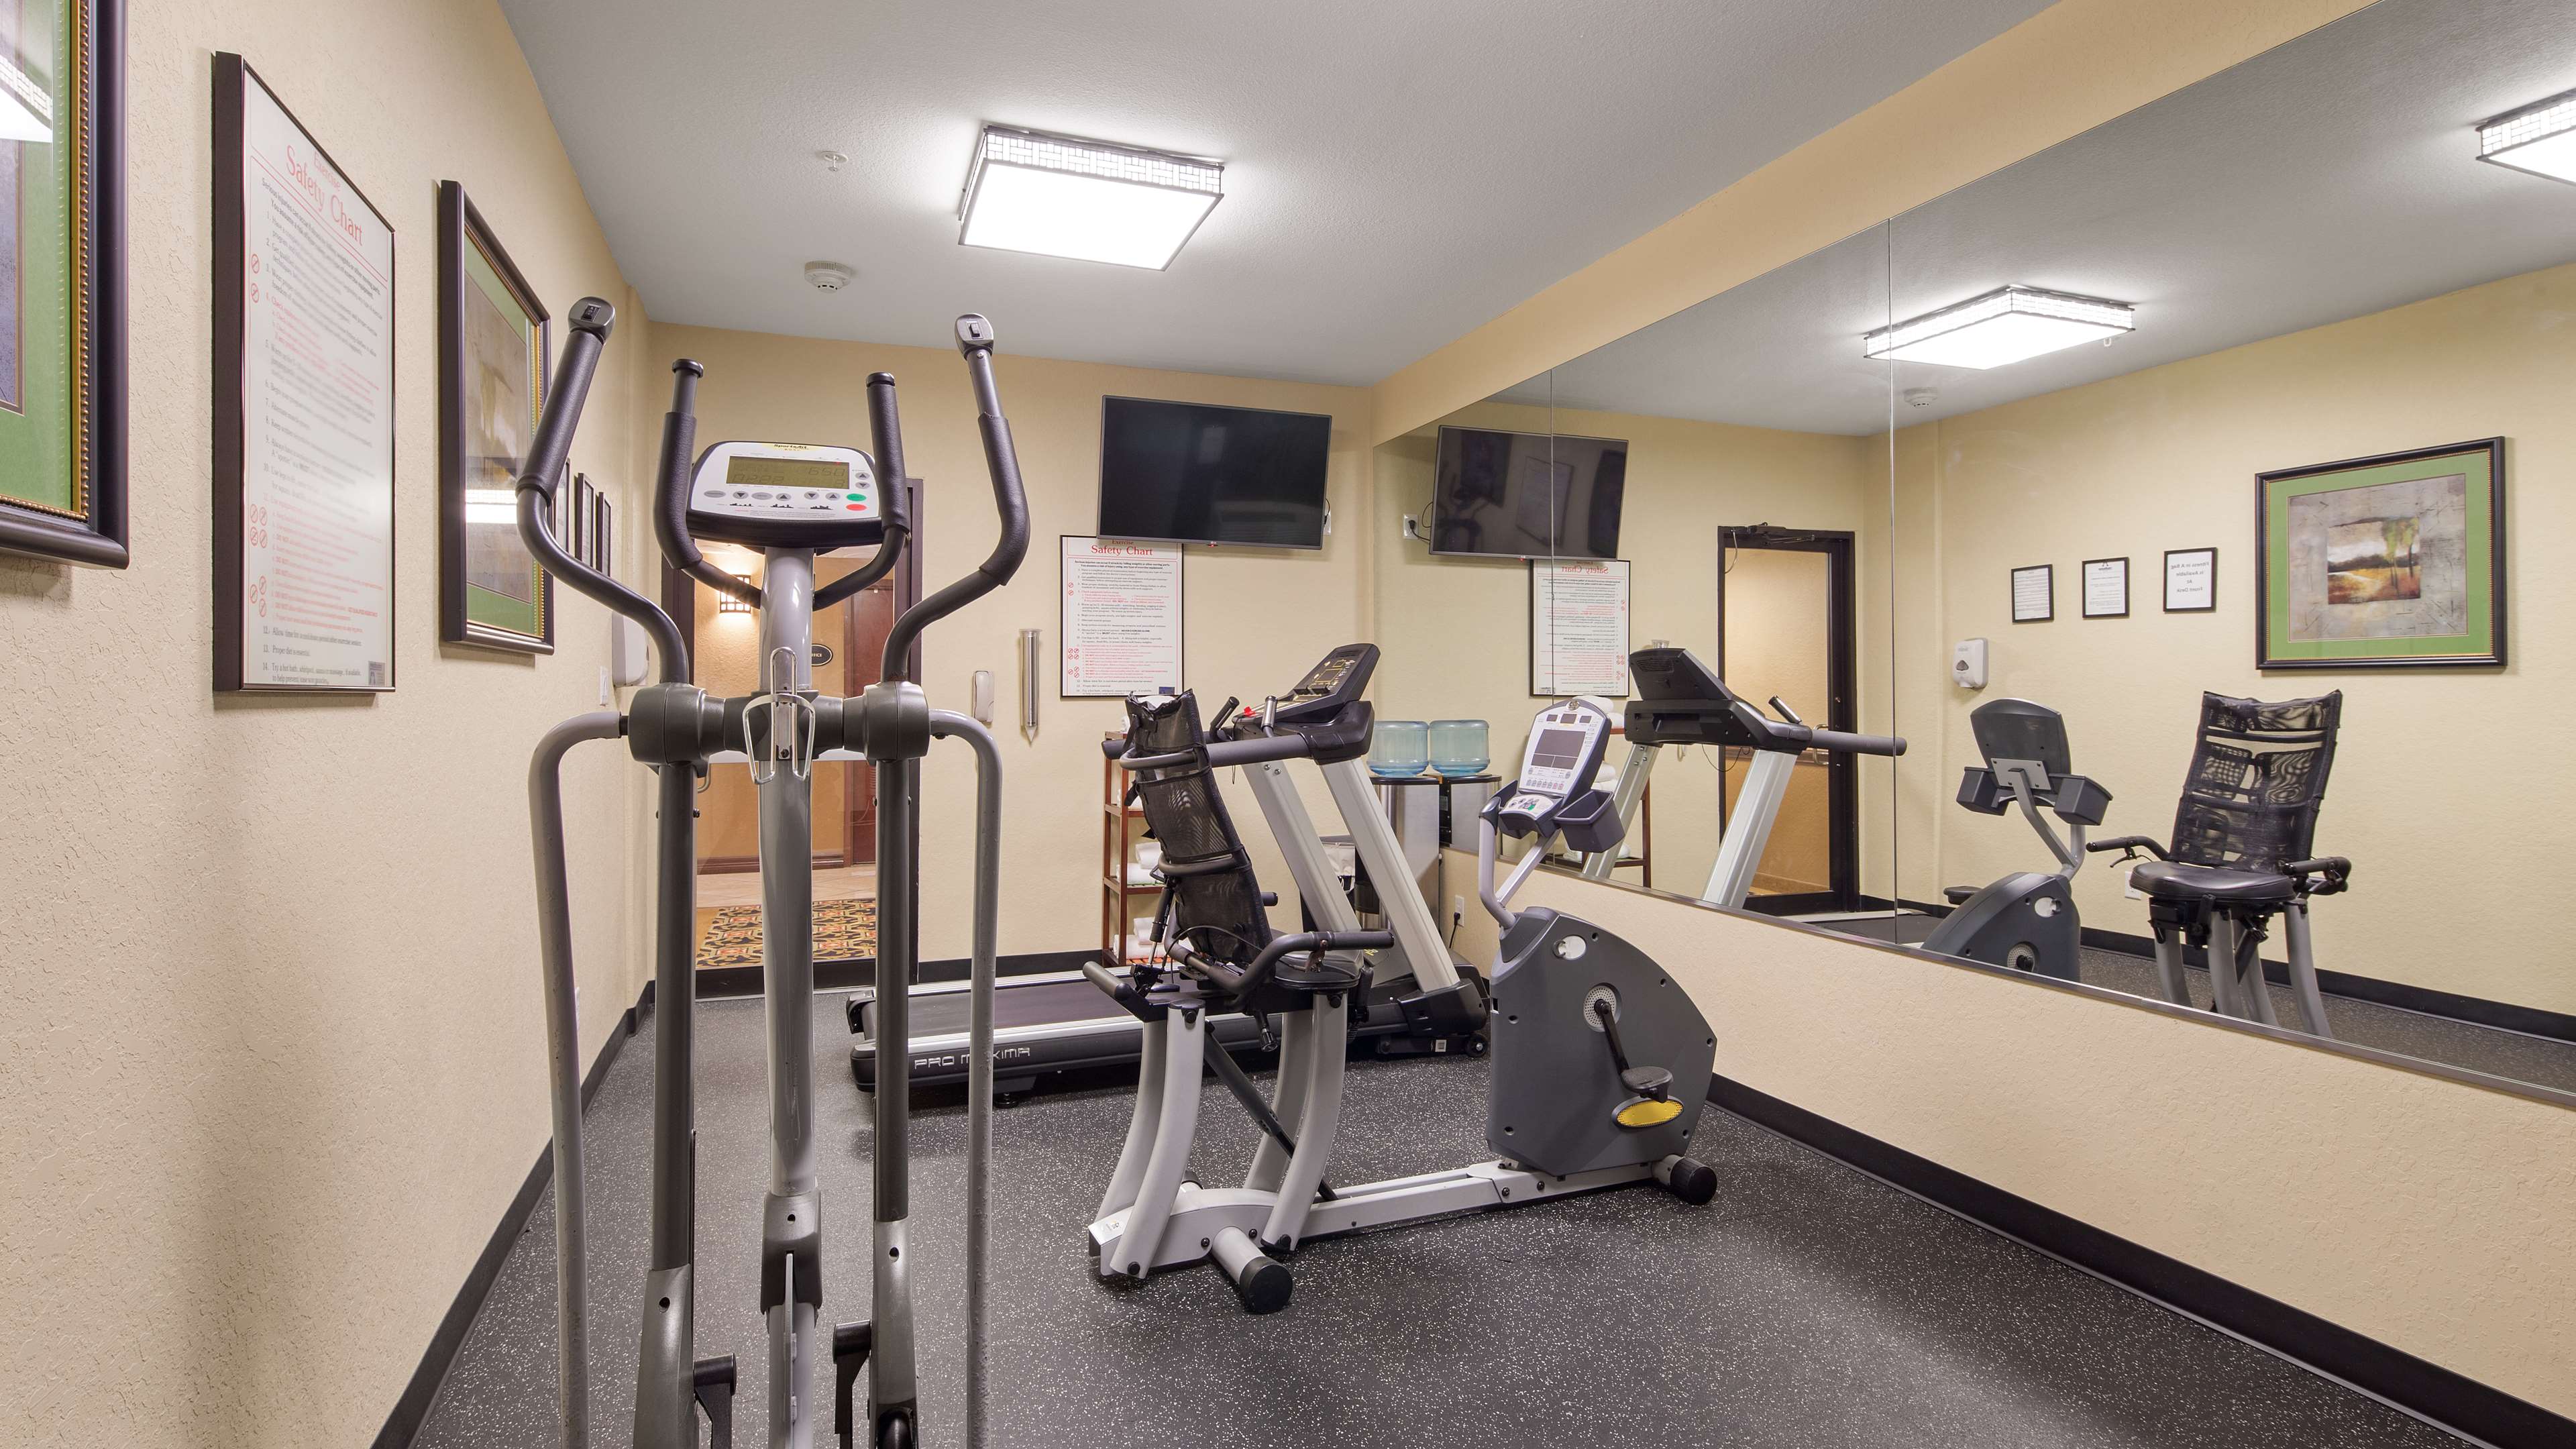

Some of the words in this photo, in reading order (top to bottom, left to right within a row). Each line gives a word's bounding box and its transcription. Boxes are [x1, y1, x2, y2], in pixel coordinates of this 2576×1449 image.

[313, 150, 340, 192] Exercise
[286, 144, 324, 213] Safety
[331, 193, 363, 246] Chart
[1091, 544, 1122, 555] Safety
[1126, 546, 1152, 555] Chart
[914, 1055, 955, 1070] PRO
[961, 1047, 1030, 1065] MXIMA
